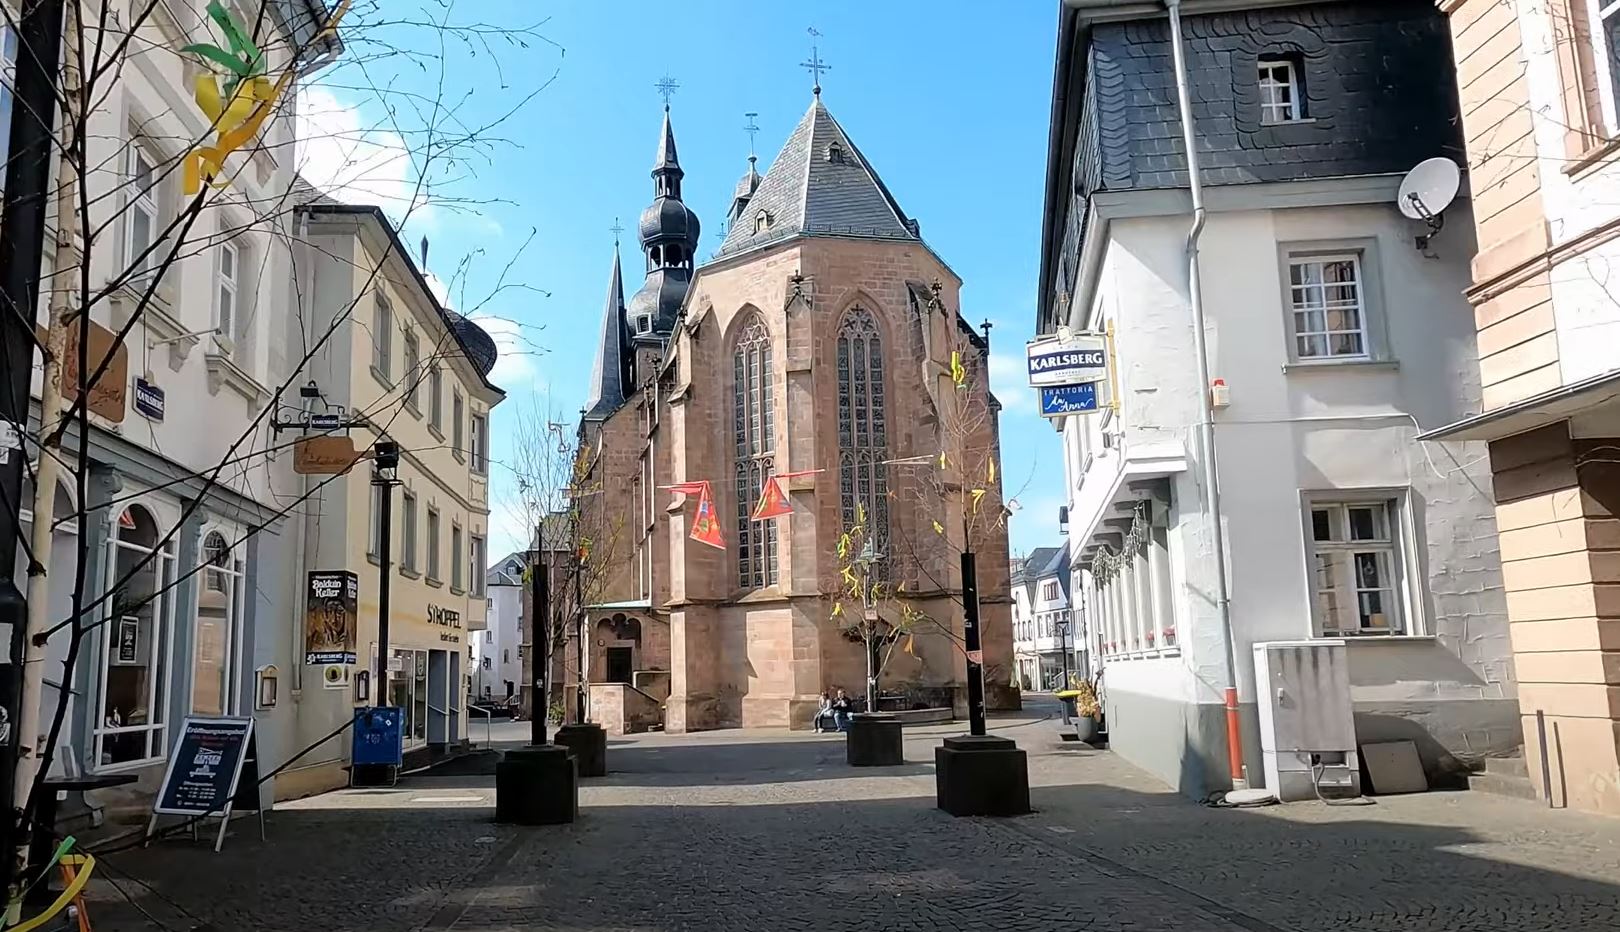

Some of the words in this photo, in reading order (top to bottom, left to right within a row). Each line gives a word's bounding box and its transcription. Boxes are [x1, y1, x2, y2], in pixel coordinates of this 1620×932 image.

[1031, 353, 1102, 370] KARLSBERG
[1043, 386, 1094, 396] TRATTORIA
[1058, 398, 1094, 412] Anna
